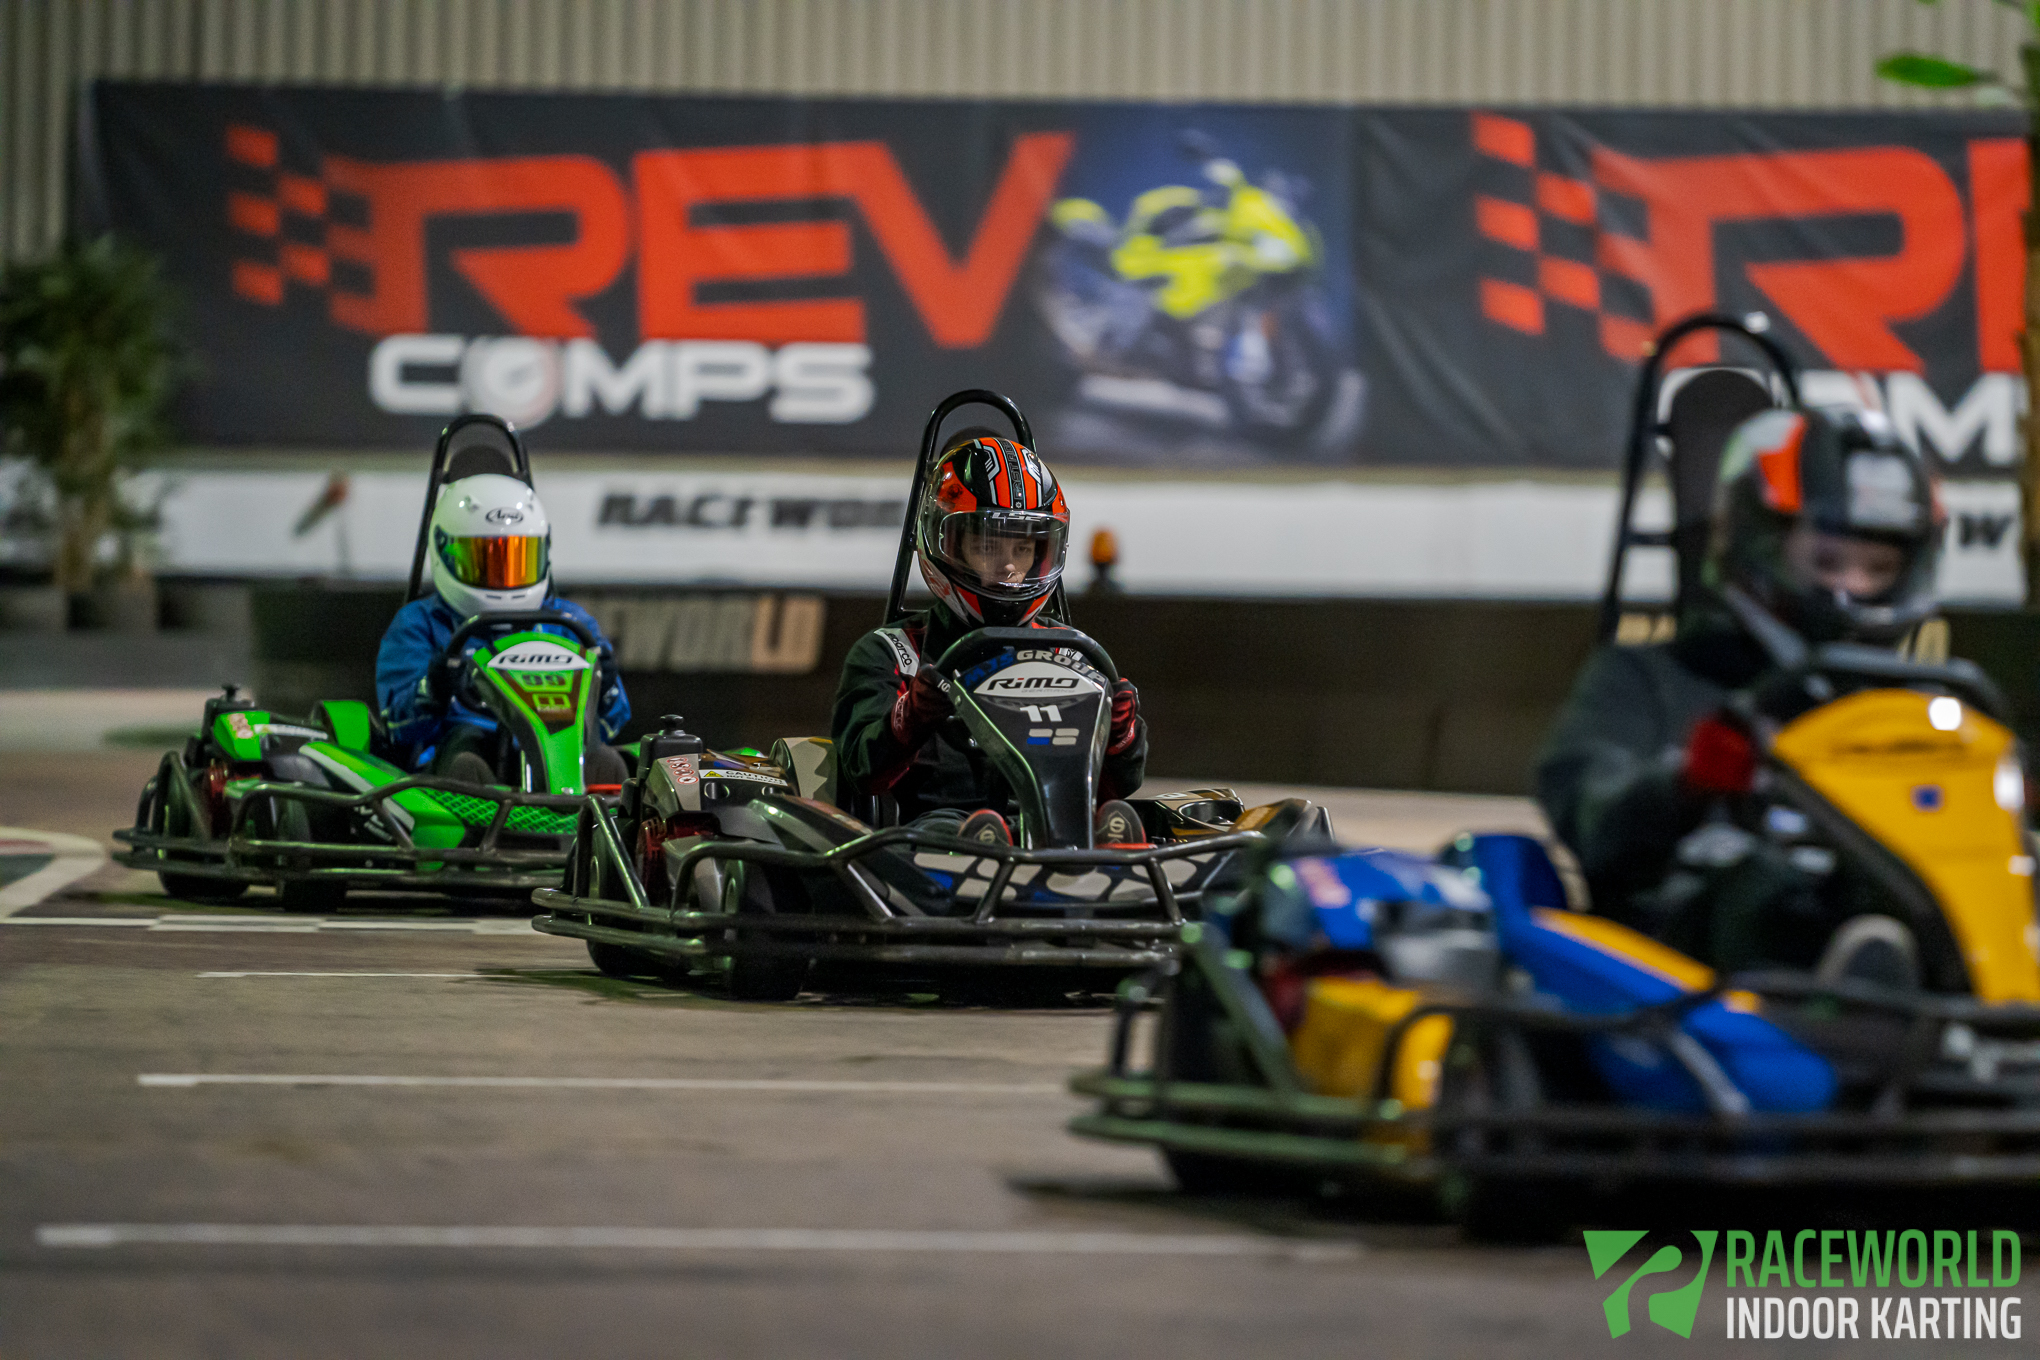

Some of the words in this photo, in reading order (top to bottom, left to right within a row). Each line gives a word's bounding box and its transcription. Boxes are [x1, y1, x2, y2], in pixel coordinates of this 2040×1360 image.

[322, 131, 1077, 349] REV
[368, 333, 874, 428] COMPS
[1016, 650, 1106, 685] GROUP
[1020, 705, 1062, 722] 11
